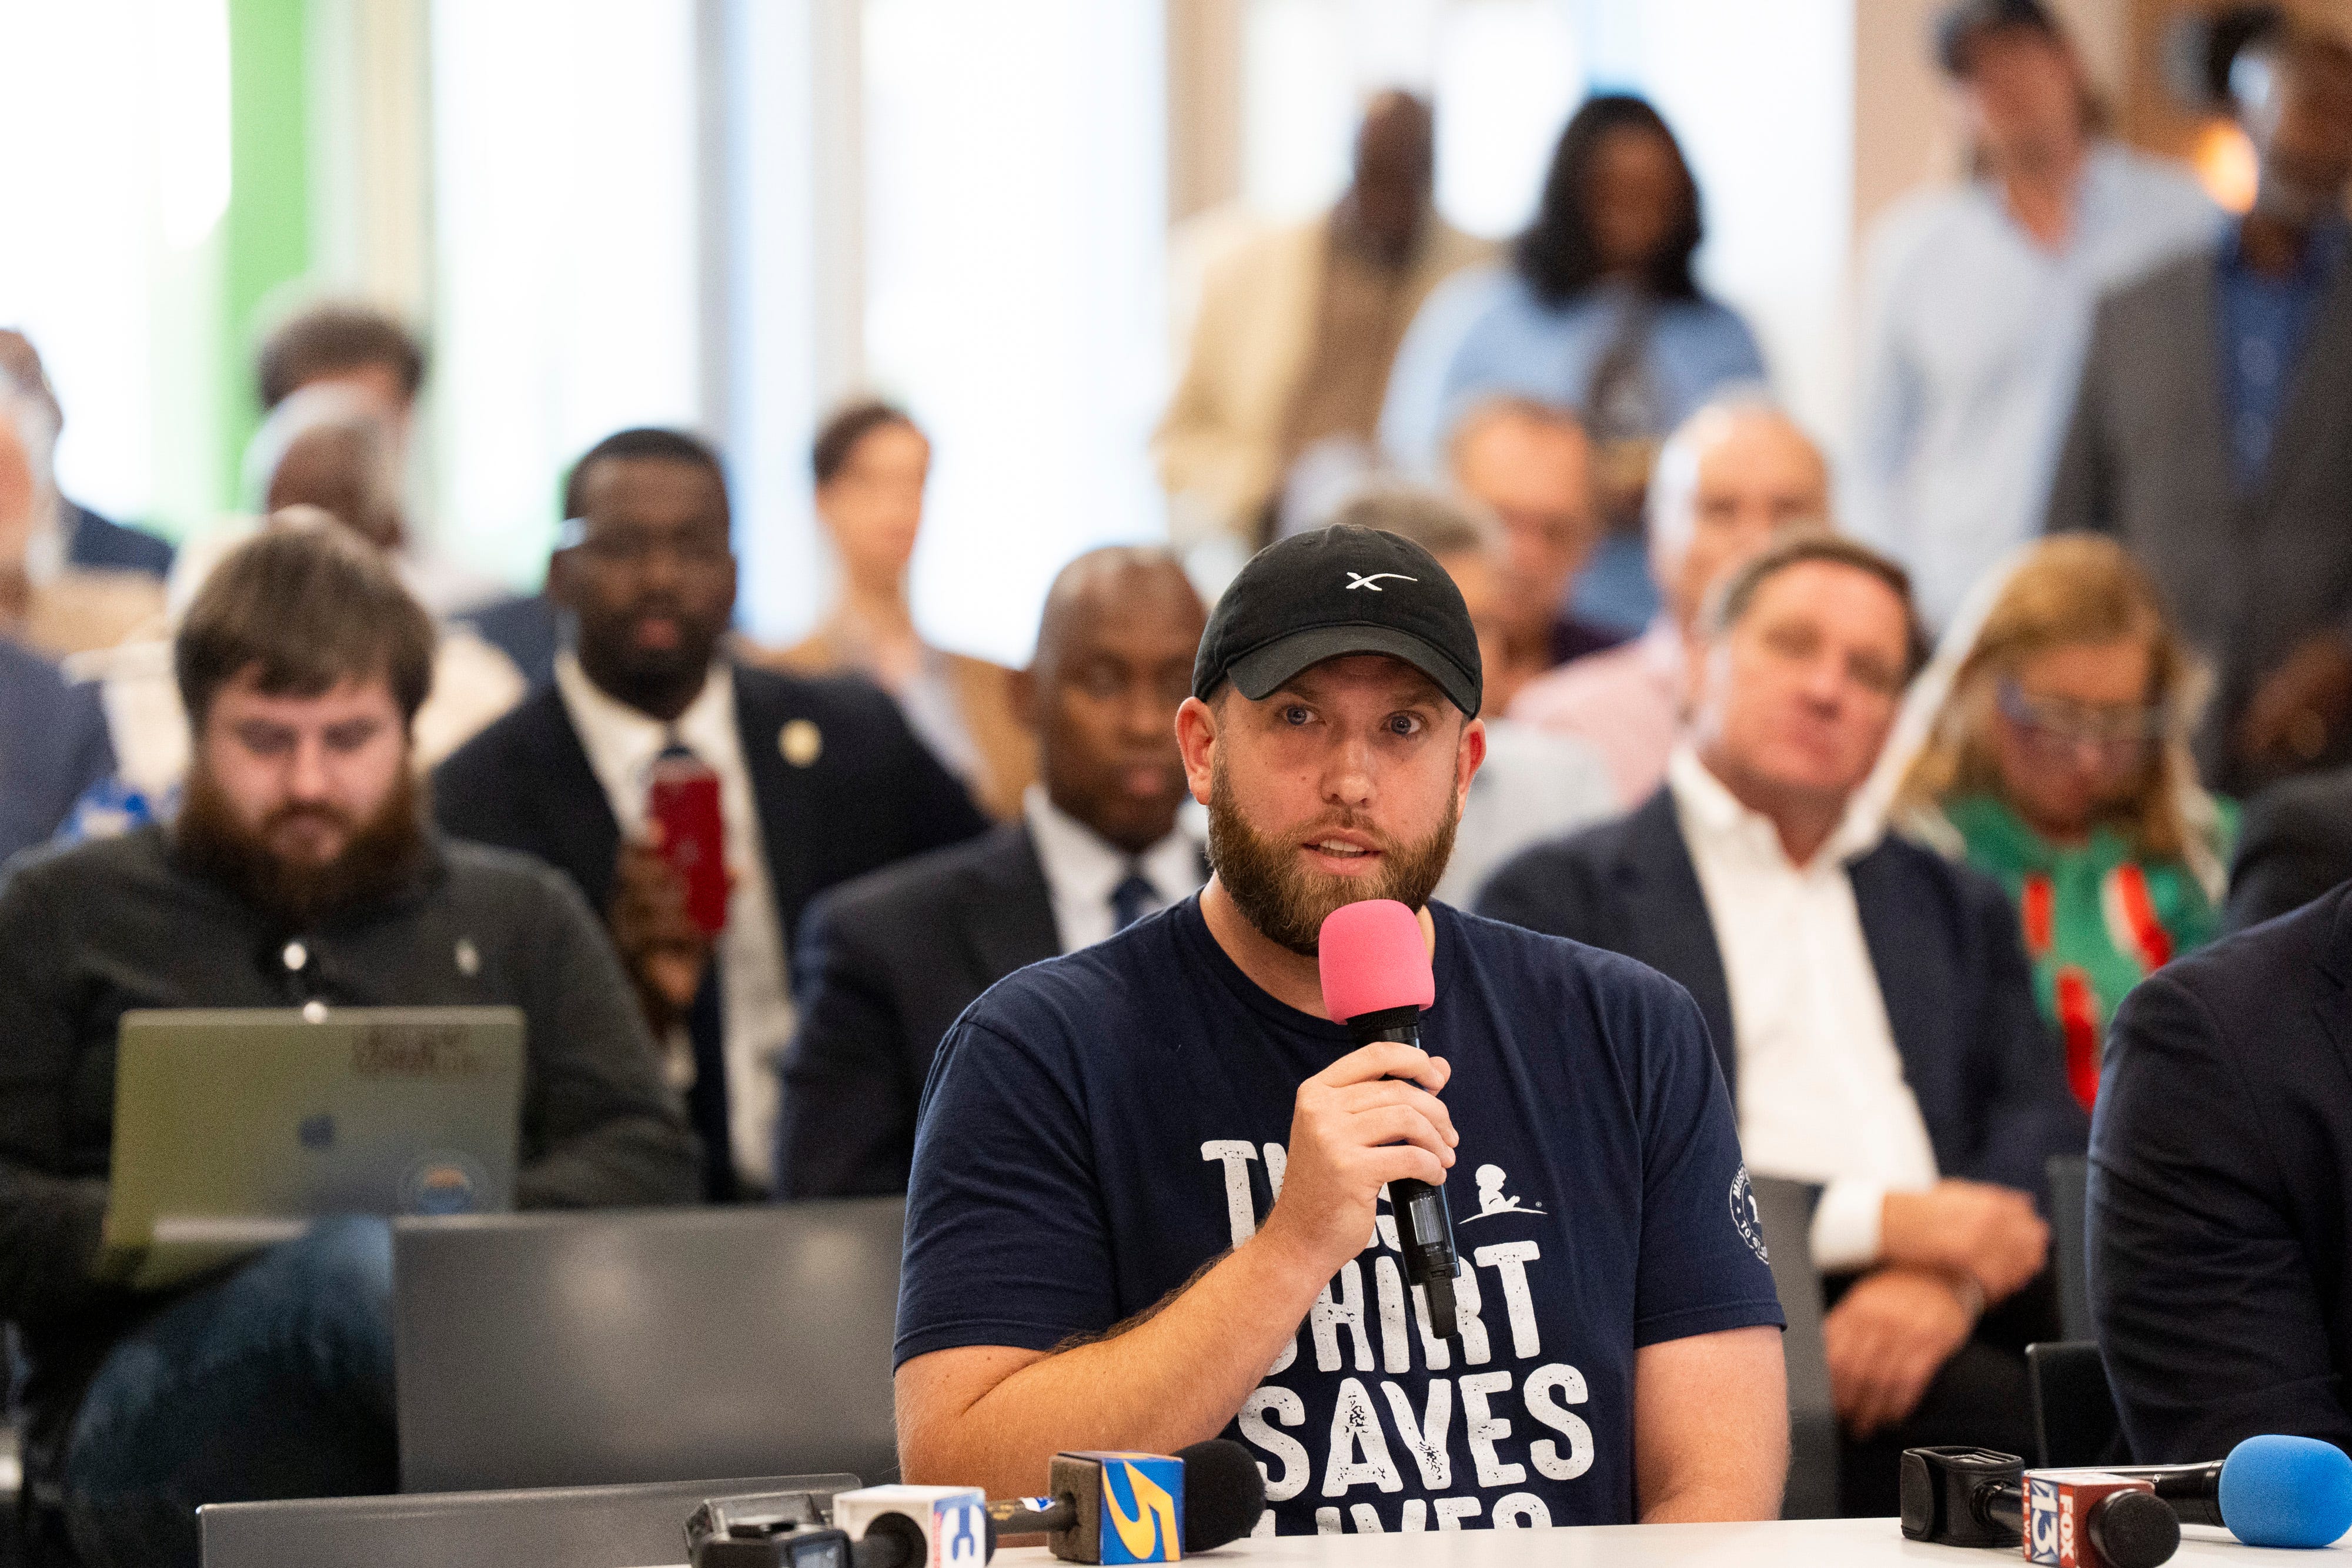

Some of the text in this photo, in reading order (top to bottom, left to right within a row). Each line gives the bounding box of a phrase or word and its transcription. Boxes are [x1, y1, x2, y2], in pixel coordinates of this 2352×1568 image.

[1741, 1220, 1751, 1238] TO
[1267, 1239, 1541, 1376] HIRT
[1238, 1363, 1594, 1502] SAVES
[1101, 1460, 1180, 1562] 5
[2032, 1489, 2057, 1556] 13
[2060, 1495, 2074, 1560] FOX
